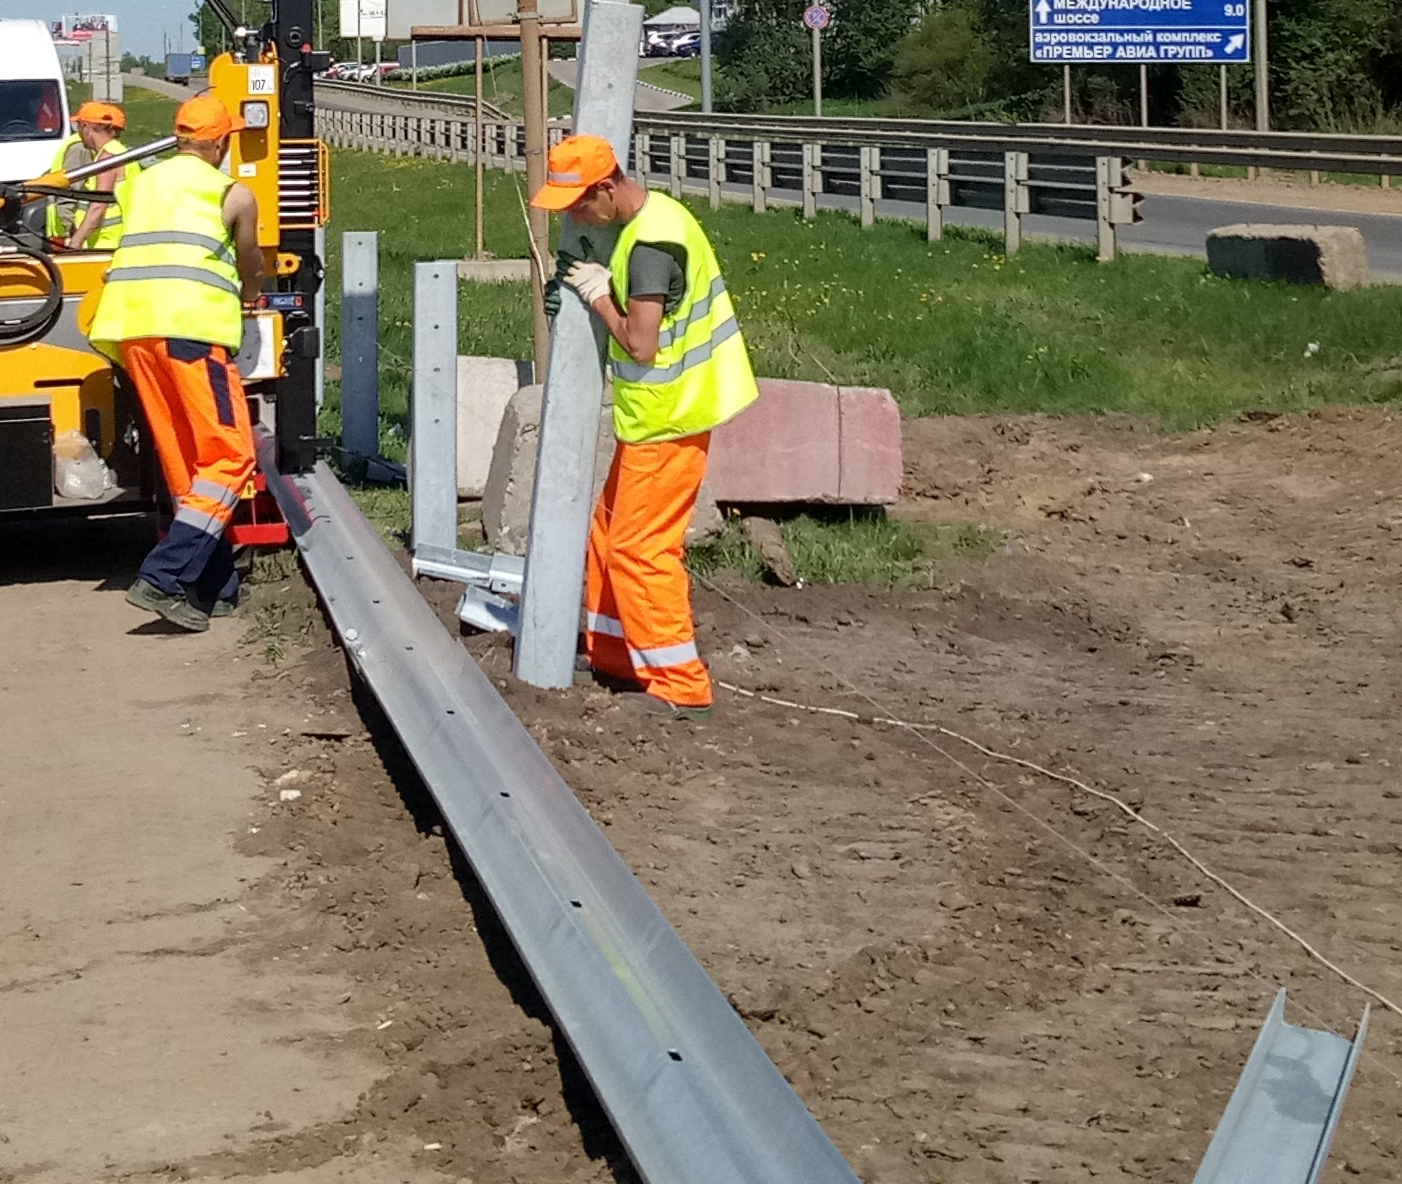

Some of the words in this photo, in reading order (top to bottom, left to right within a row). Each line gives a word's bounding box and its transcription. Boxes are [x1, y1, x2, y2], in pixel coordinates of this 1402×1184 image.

[1224, 4, 1245, 16] 9.0
[1053, 13, 1099, 24] шоссе
[1035, 30, 1154, 44] аэровокзальный
[1156, 32, 1222, 43] комплекс
[1035, 45, 1113, 58] «ПРЕМЬЕР
[1116, 45, 1157, 58] АВИА
[1160, 45, 1214, 58] ГРУПП»
[251, 79, 266, 91] 107
